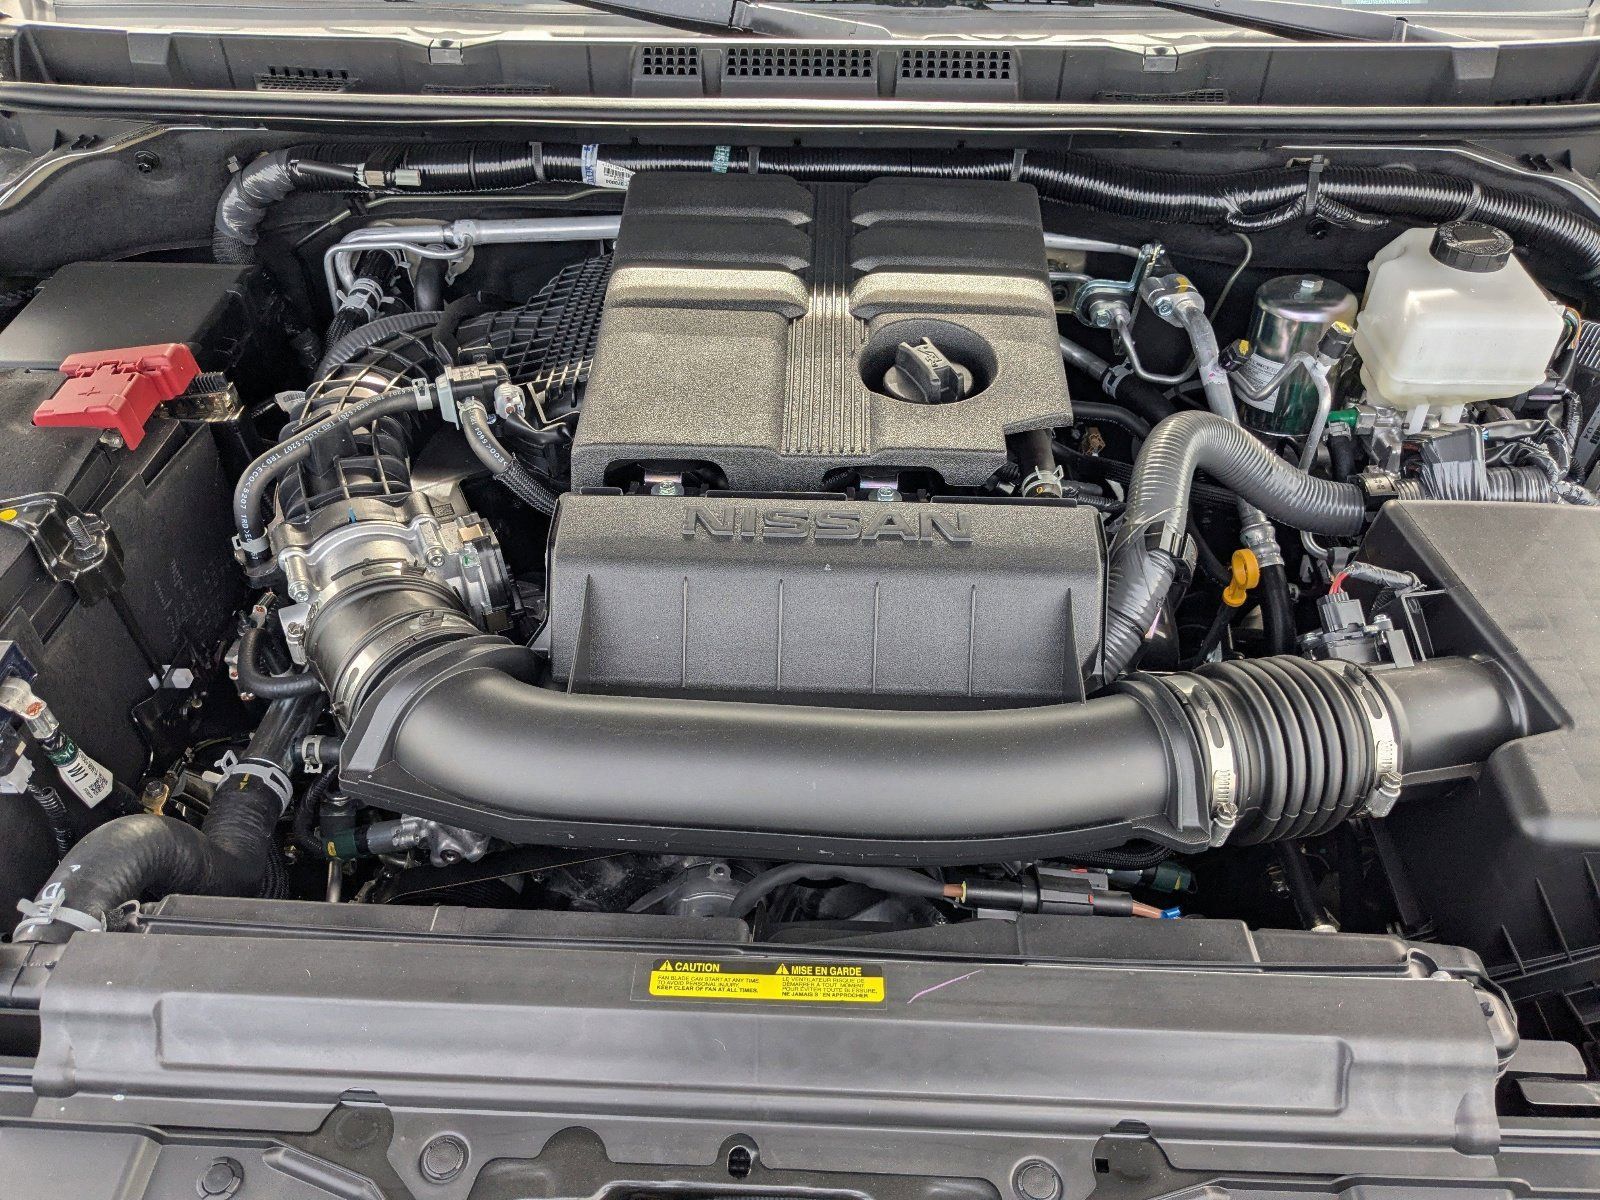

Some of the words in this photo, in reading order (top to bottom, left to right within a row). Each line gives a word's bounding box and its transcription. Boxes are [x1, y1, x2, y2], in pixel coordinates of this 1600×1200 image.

[682, 505, 972, 542] NISSAN
[675, 962, 720, 973] CAUTION
[791, 965, 813, 976] MISE
[815, 966, 828, 976] EN
[830, 966, 862, 977] GARDE
